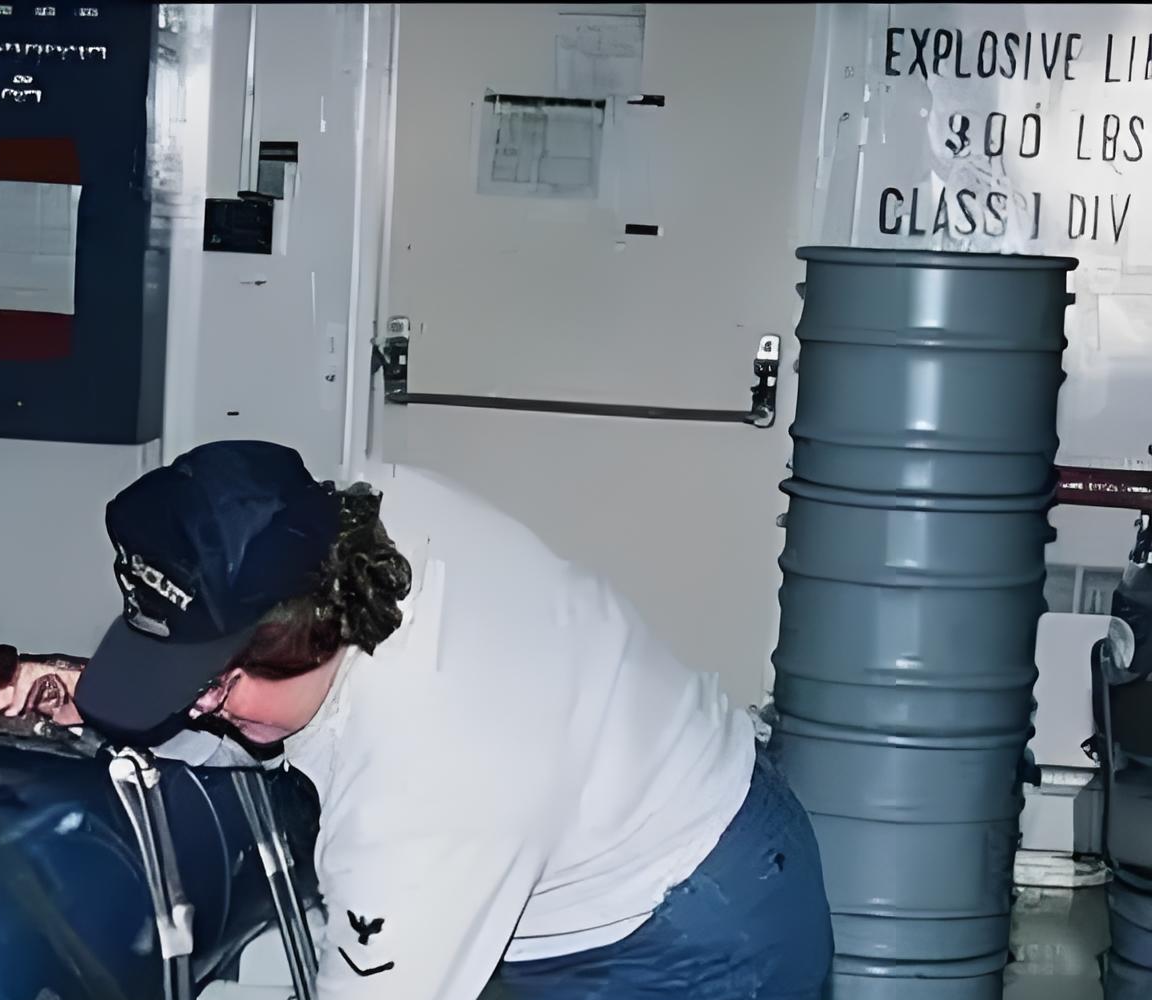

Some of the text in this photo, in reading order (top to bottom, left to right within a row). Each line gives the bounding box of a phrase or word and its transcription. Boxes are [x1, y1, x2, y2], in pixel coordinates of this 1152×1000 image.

[885, 27, 1083, 81] EXPLOSIVE
[1076, 113, 1145, 162] LBS
[879, 186, 1008, 237] CLASS
[1067, 192, 1132, 244] DIV
